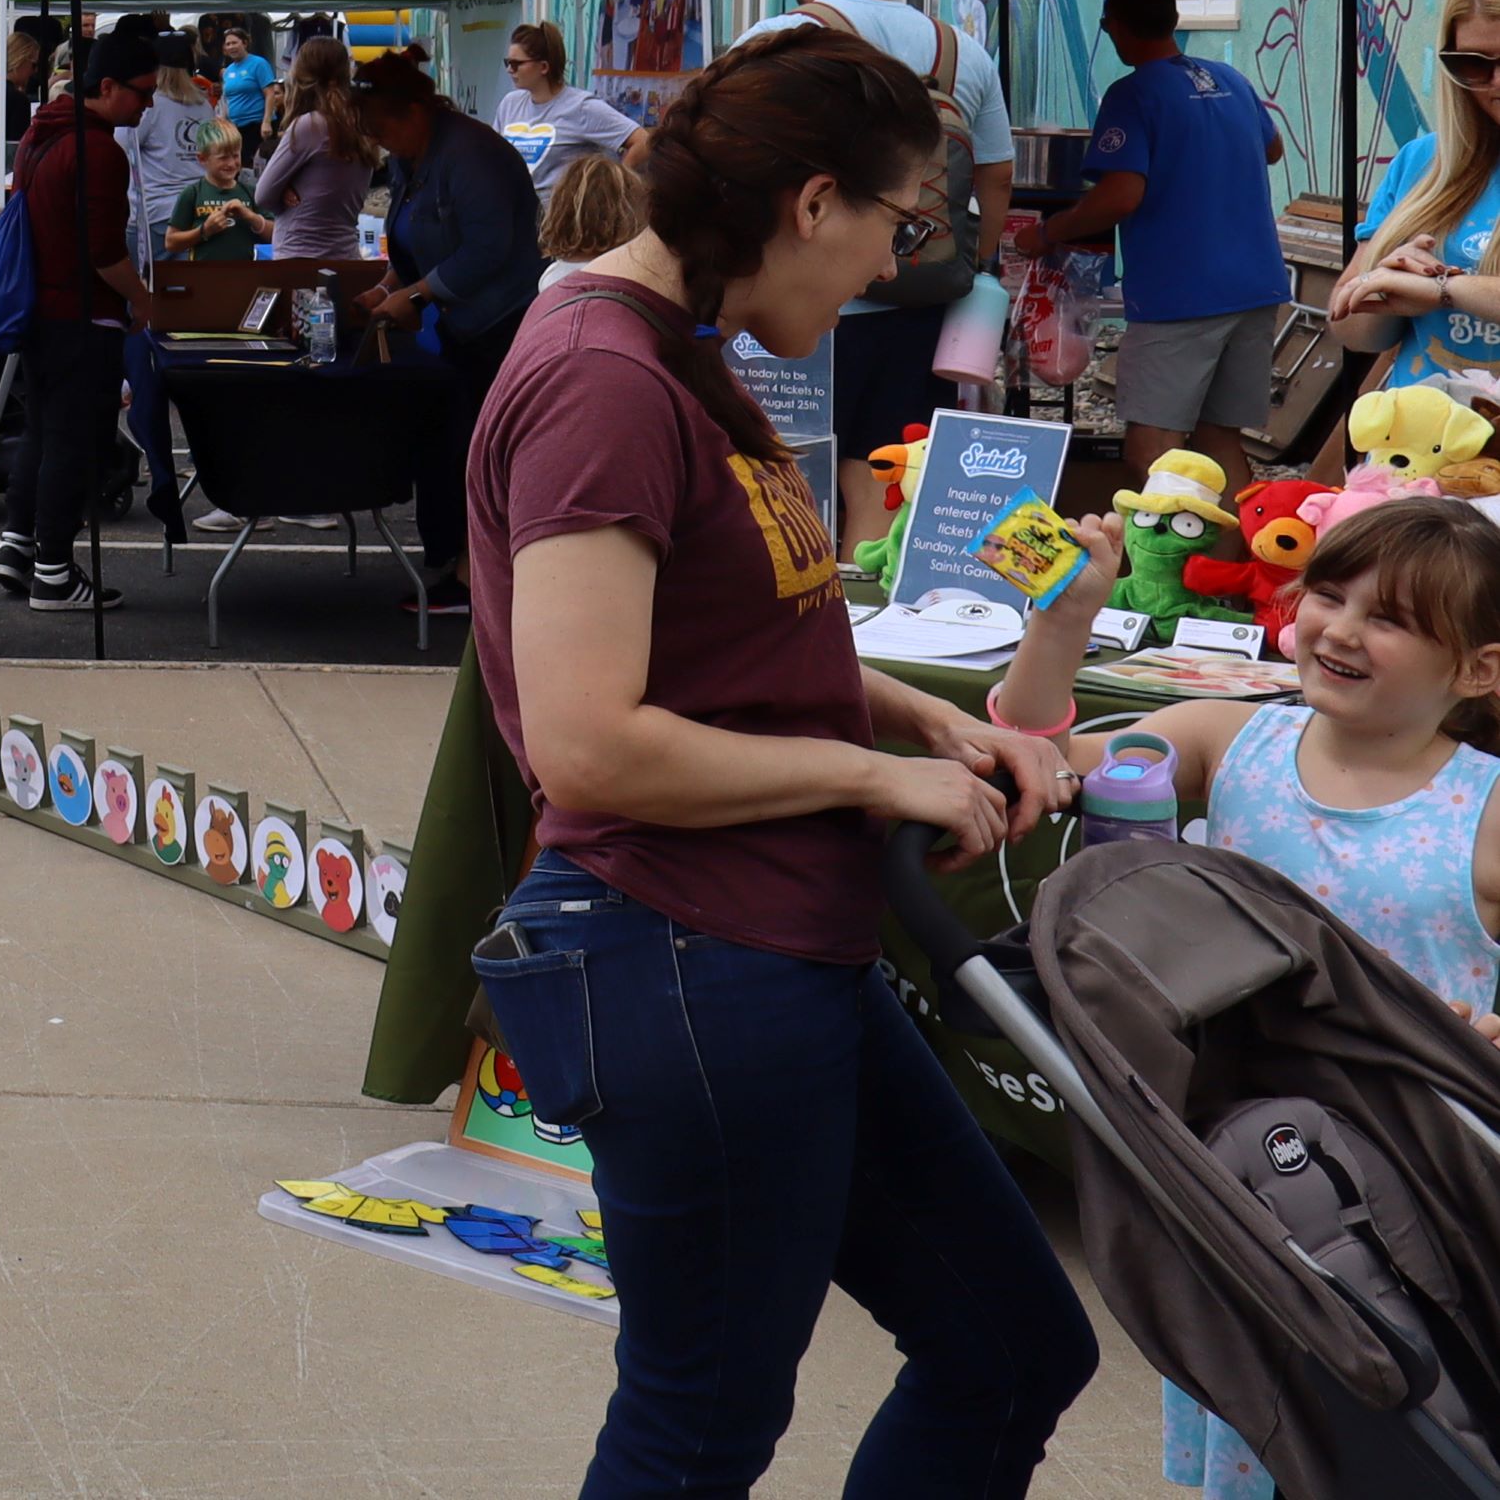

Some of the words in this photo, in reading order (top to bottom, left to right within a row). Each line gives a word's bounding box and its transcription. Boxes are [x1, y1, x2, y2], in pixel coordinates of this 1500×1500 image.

[1449, 314, 1500, 344] Big
[733, 367, 746, 376] ire
[748, 368, 779, 380] today
[780, 369, 790, 379] to
[793, 369, 807, 381] be
[752, 383, 769, 393] win
[771, 384, 778, 393] 4
[780, 384, 813, 396] tickets
[814, 385, 825, 397] to
[761, 398, 795, 411] August
[797, 399, 819, 411] 25th
[768, 414, 794, 424] ame!
[960, 443, 1027, 473] Saints
[947, 486, 987, 503] Inquire
[990, 493, 1001, 506] to
[933, 505, 979, 521] entered
[982, 511, 994, 523] to
[938, 522, 974, 539] tickets
[912, 537, 957, 556] Sunday,
[929, 558, 961, 575] Saints
[1272, 1134, 1305, 1165] chicco
